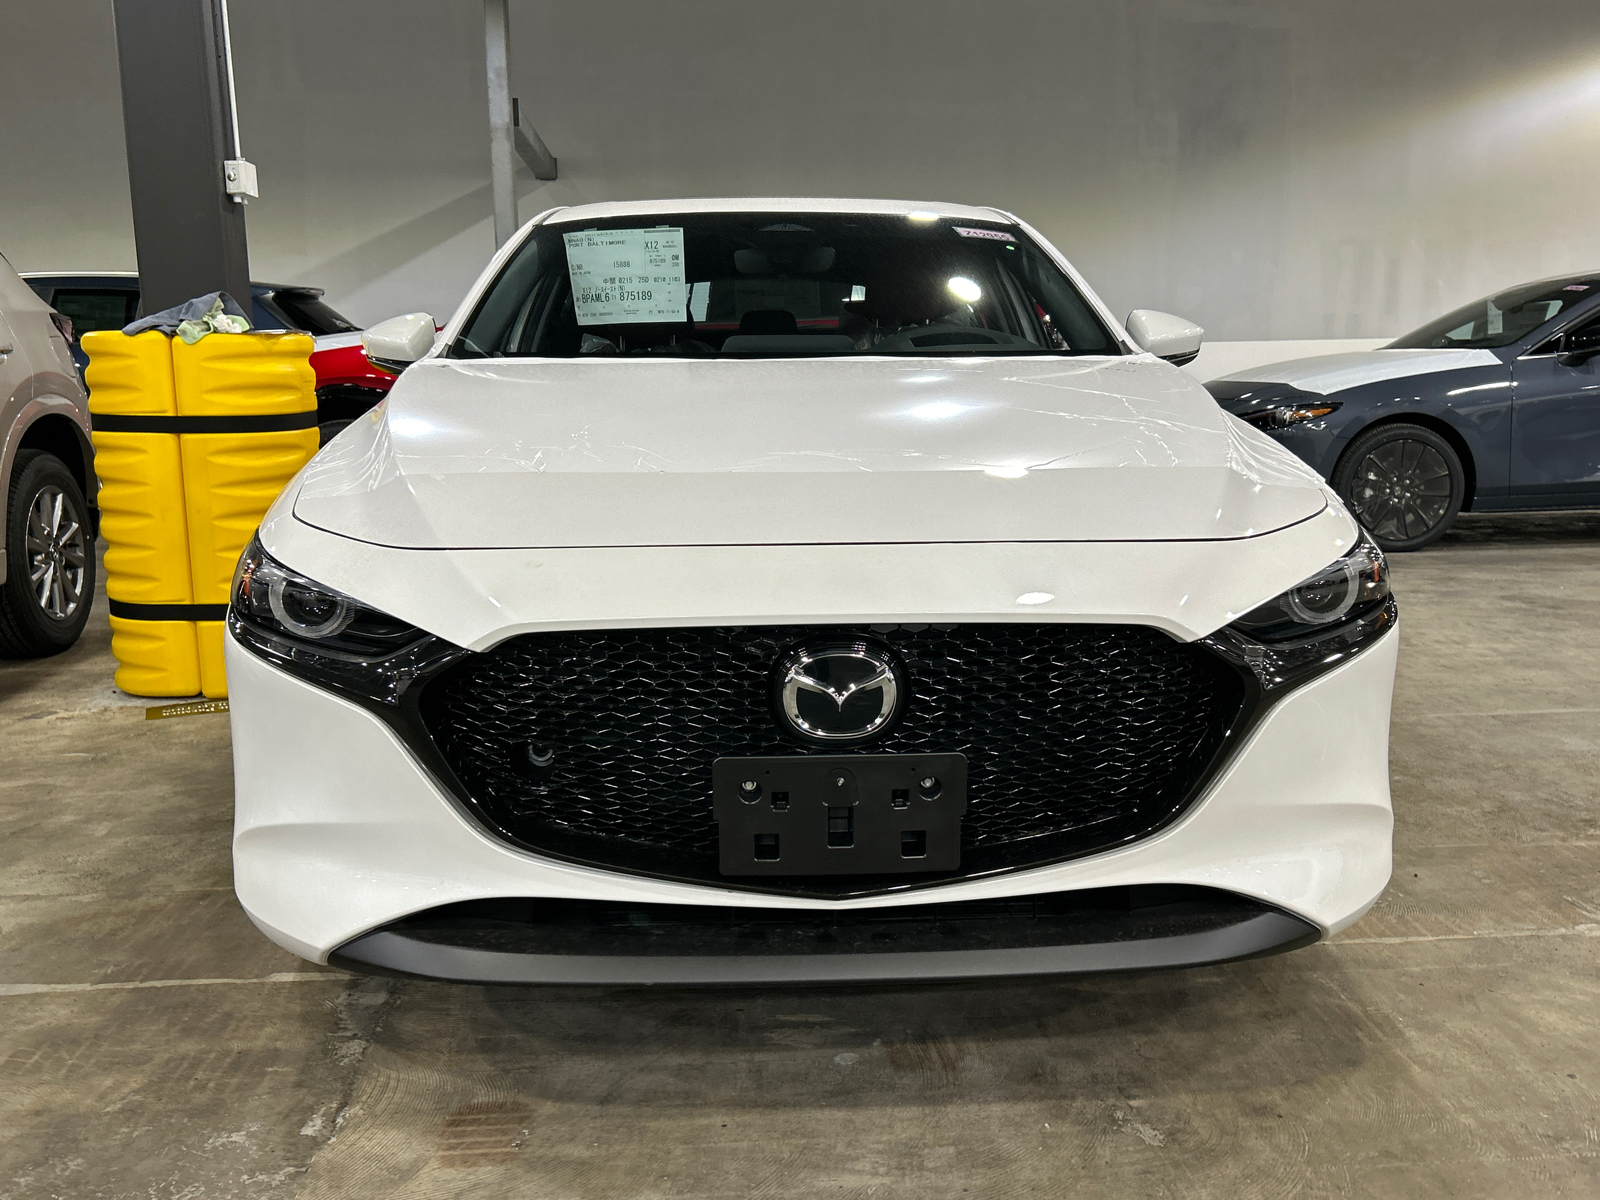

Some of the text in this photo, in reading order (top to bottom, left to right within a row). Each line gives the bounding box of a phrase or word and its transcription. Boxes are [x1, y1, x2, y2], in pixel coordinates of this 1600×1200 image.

[644, 240, 659, 249] X12
[618, 276, 633, 284] 0215
[638, 276, 650, 284] 25D
[619, 290, 653, 302] 875189
